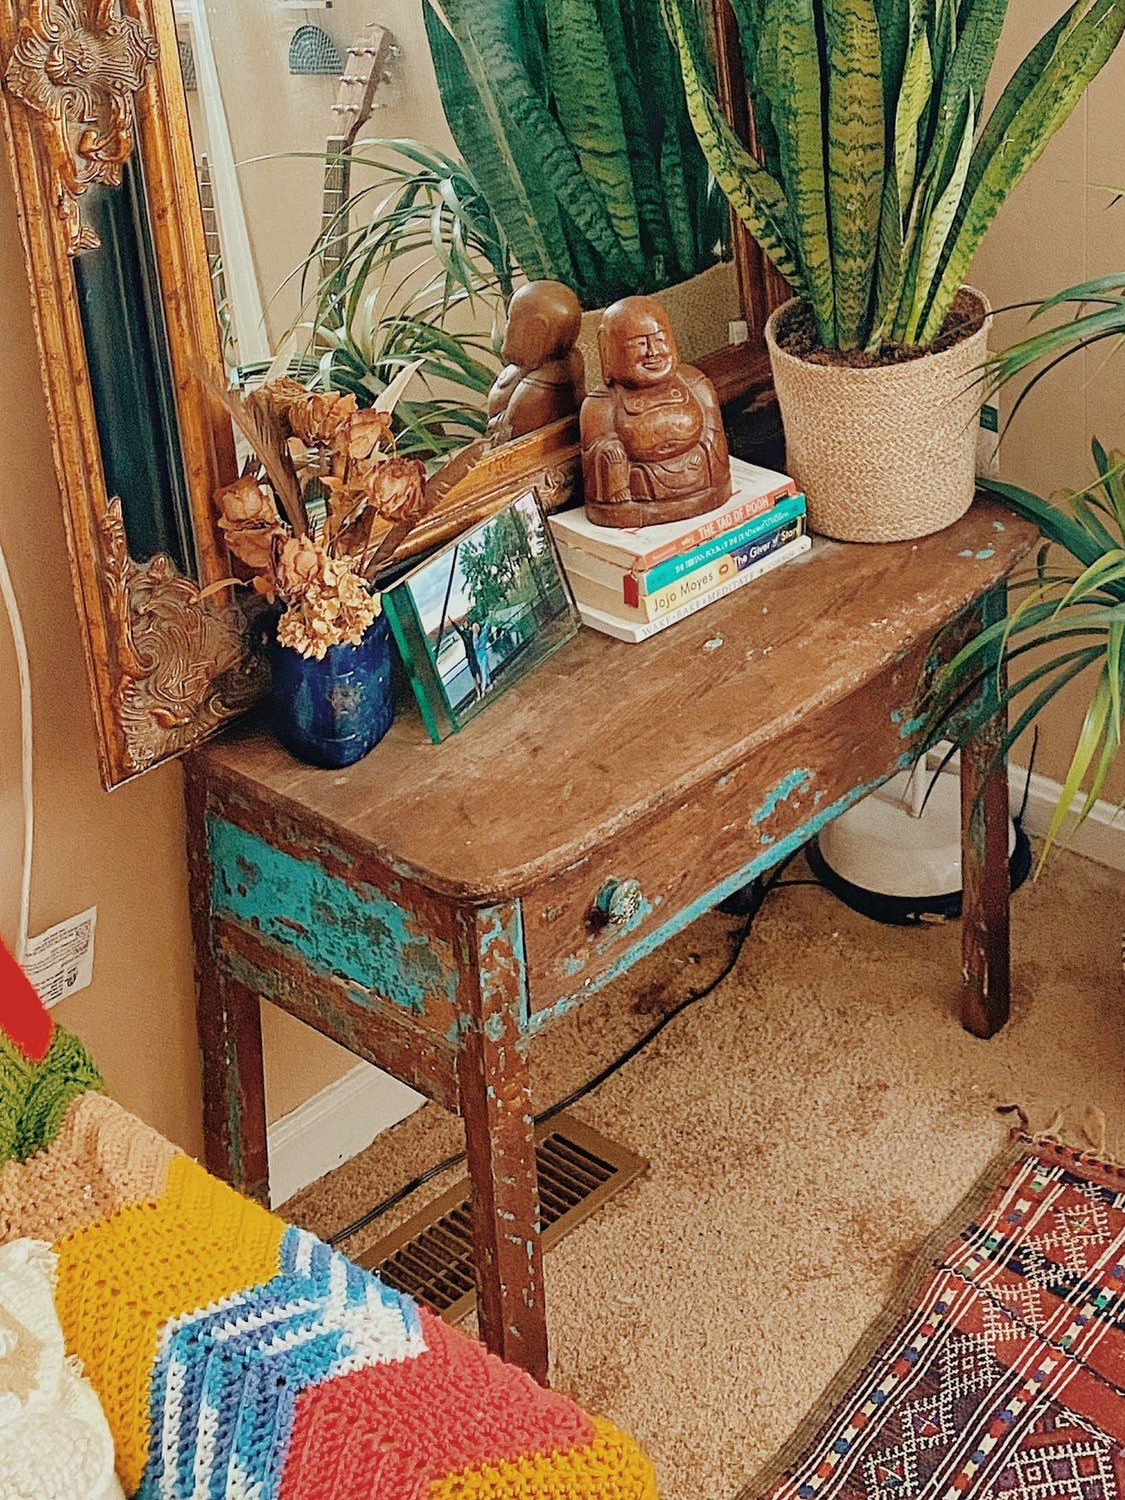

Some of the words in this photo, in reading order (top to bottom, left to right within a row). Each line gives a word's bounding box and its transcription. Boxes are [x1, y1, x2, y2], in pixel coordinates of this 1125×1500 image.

[698, 521, 715, 538] THE
[717, 512, 733, 531] TAO
[733, 506, 745, 521] OF
[745, 496, 769, 516] POOH
[733, 554, 748, 569] The
[654, 593, 677, 612] Jojo
[680, 572, 714, 596] Moyes
